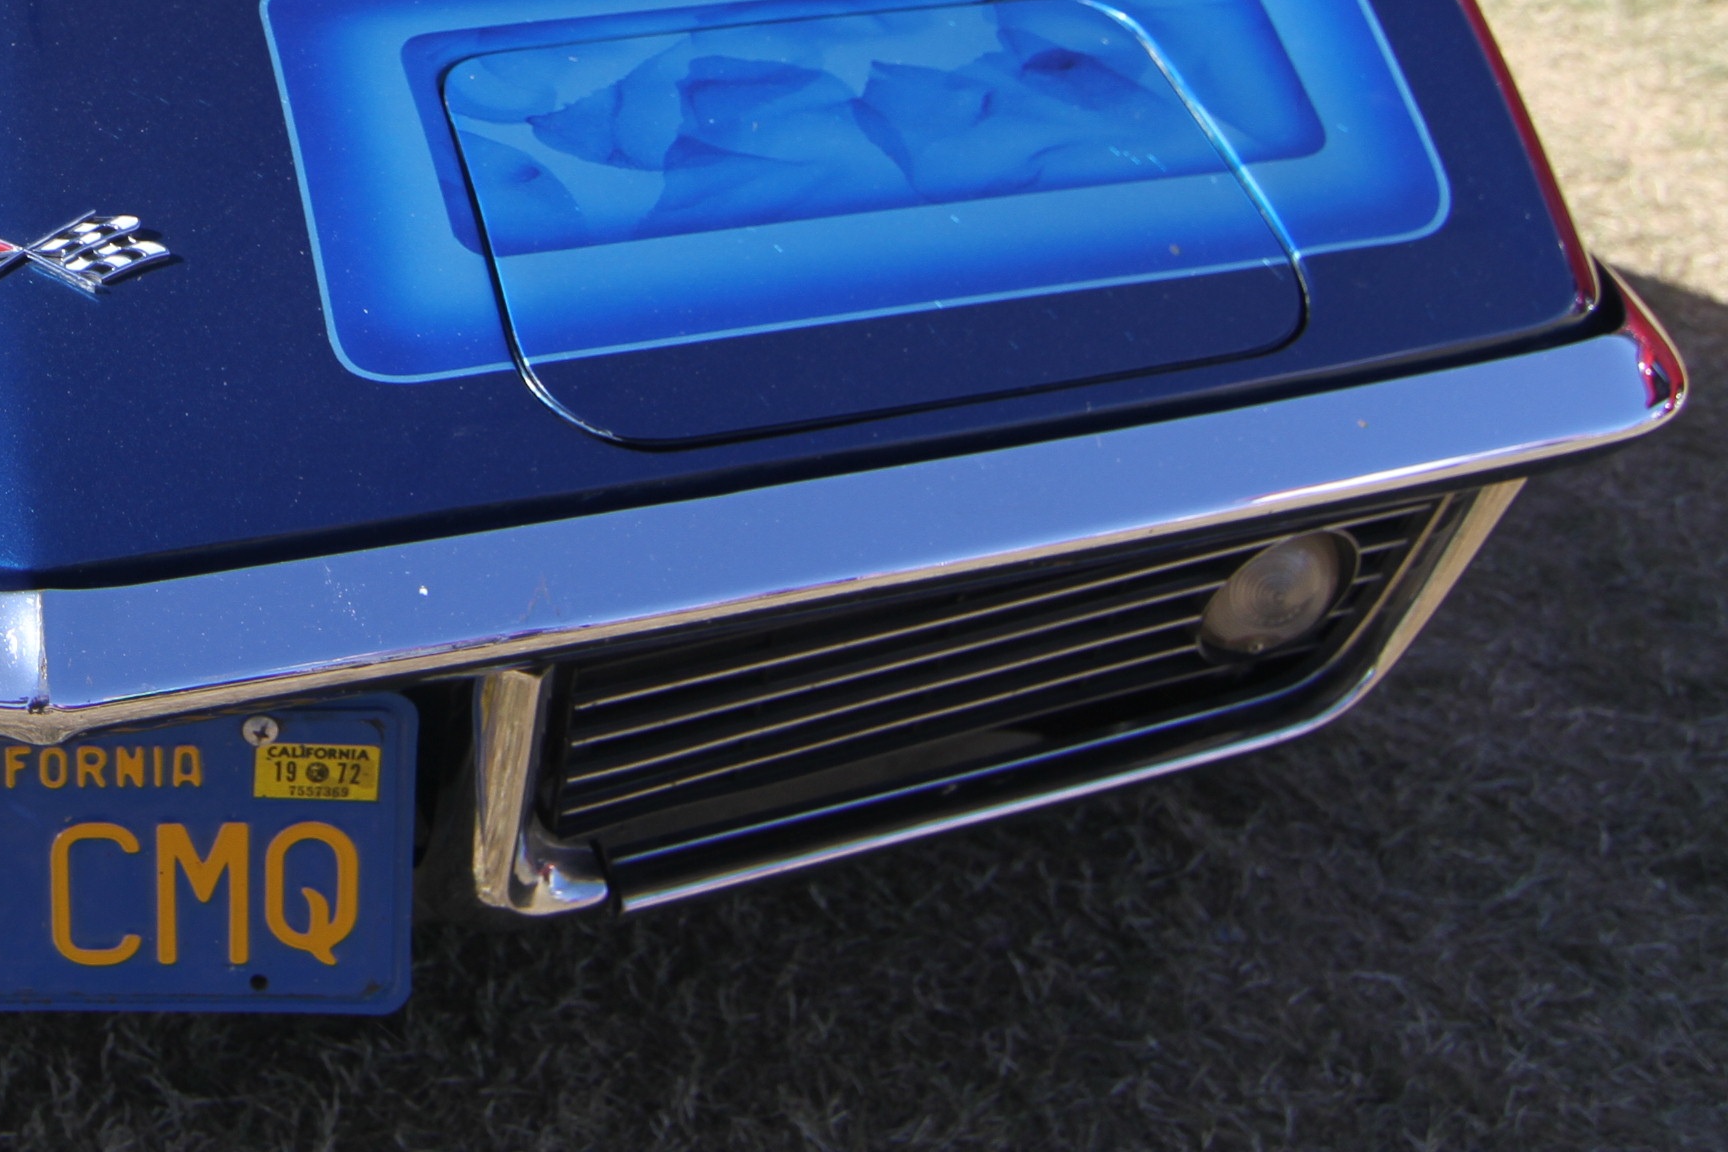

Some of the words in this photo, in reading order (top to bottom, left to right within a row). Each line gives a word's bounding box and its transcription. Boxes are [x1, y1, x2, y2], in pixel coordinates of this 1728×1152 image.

[267, 746, 369, 760] CALIFORNIA
[274, 761, 297, 783] 19
[337, 762, 361, 785] 72
[50, 821, 358, 965] CMQ
